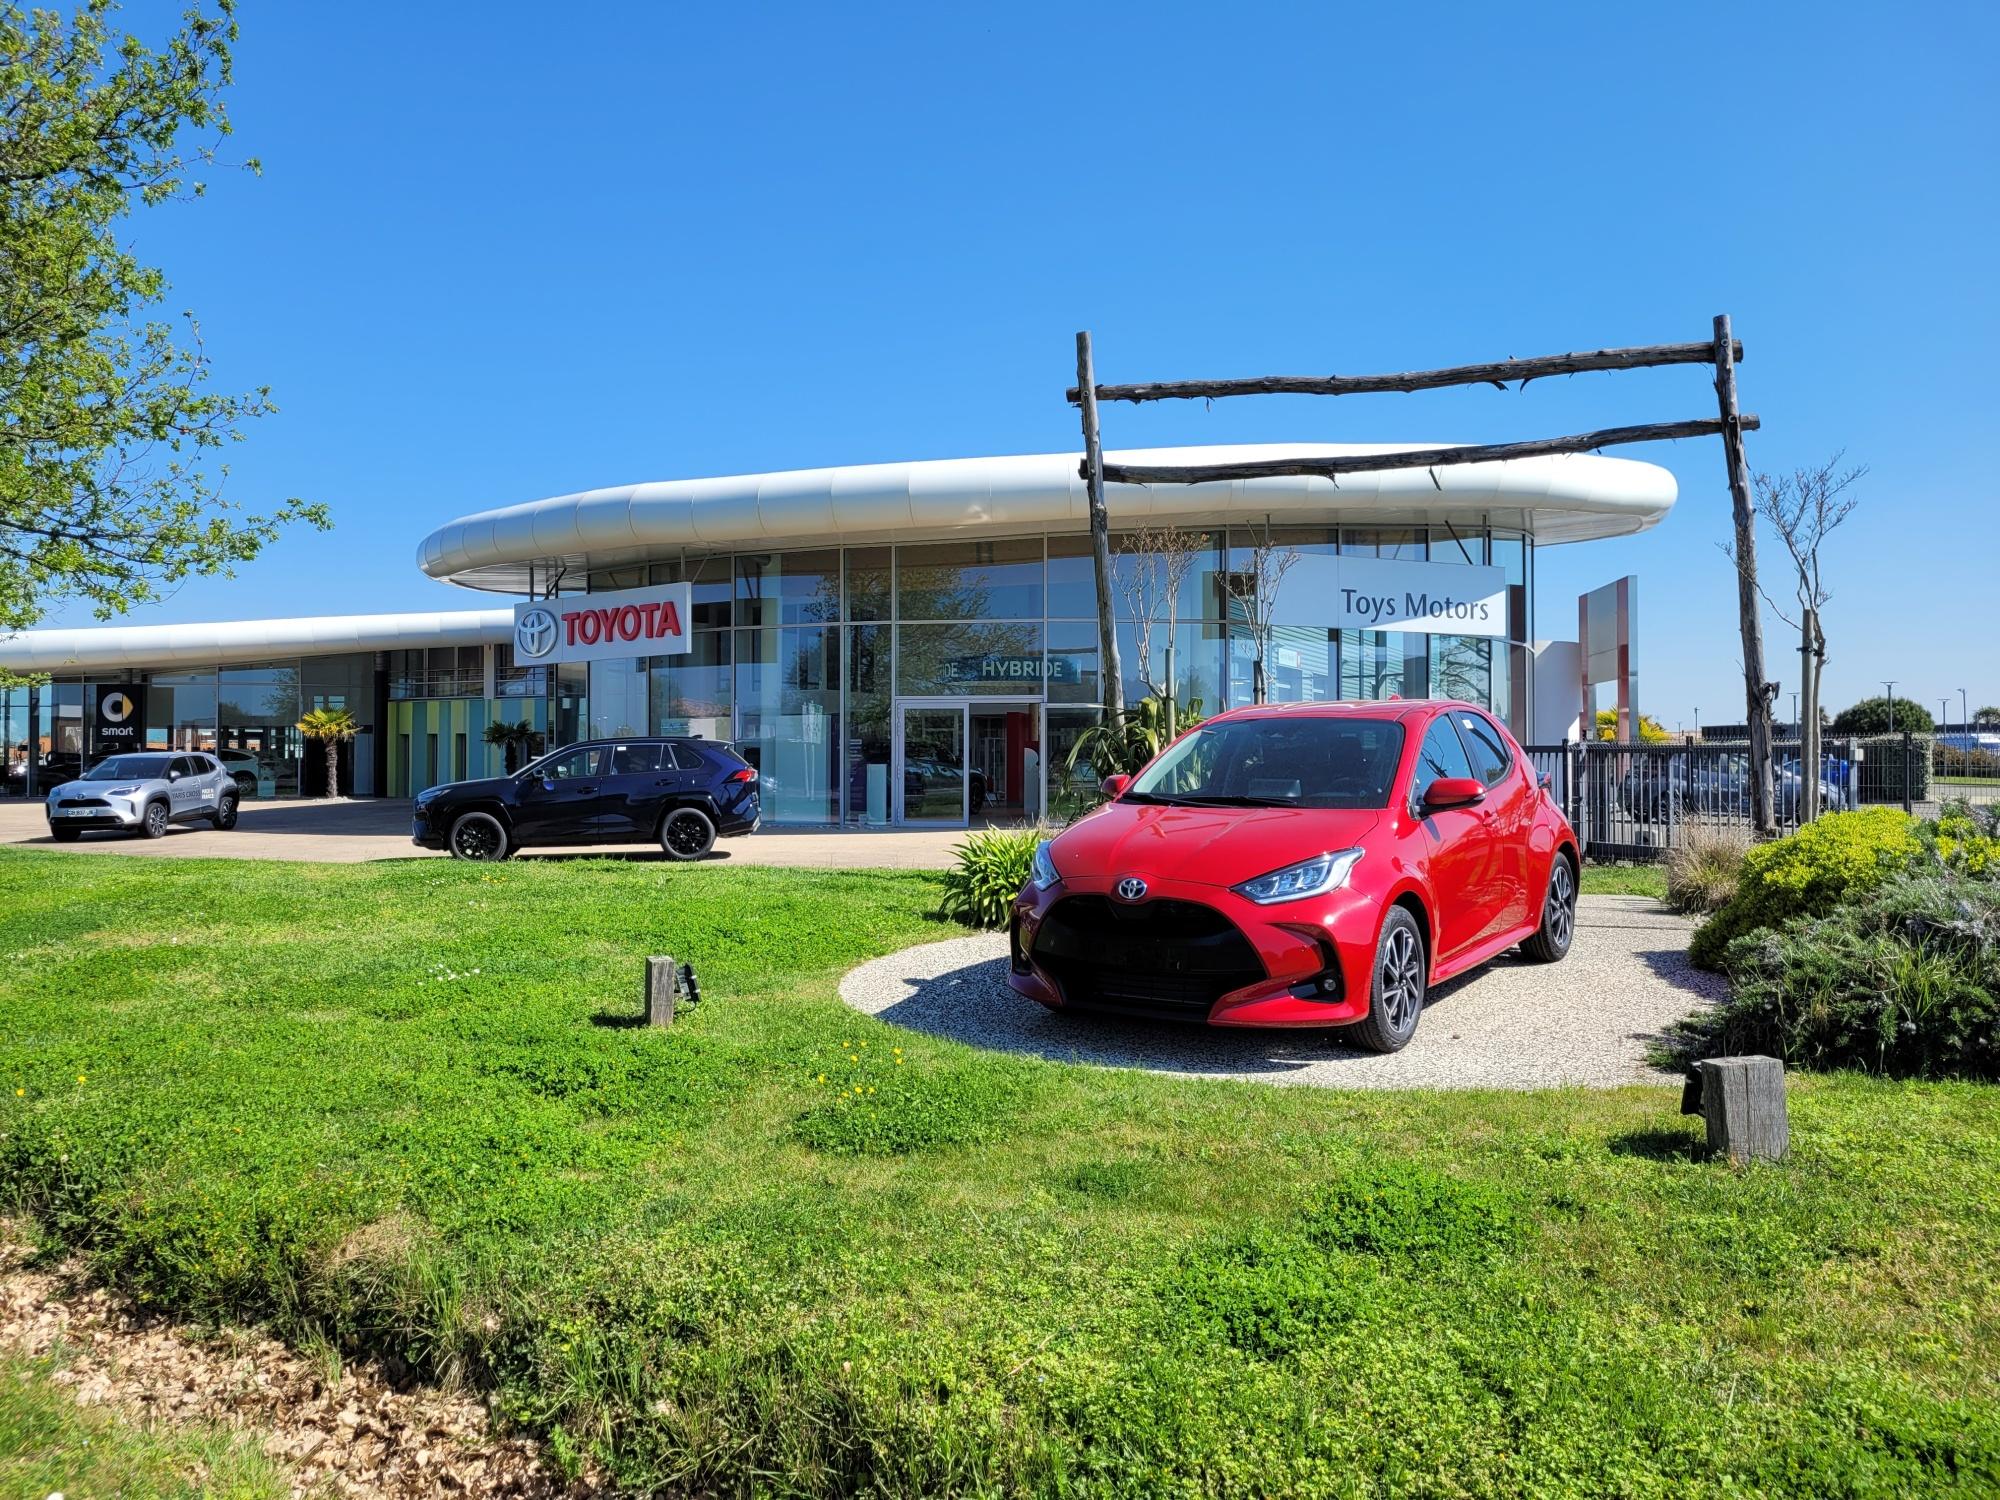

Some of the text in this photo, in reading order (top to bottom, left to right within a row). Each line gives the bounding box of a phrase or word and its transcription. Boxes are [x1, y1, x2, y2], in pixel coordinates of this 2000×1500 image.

[1341, 588, 1489, 623] Toys Motors
[561, 601, 682, 646] TOYOTA
[982, 660, 1063, 678] HYBRIDE
[101, 727, 134, 736] smart
